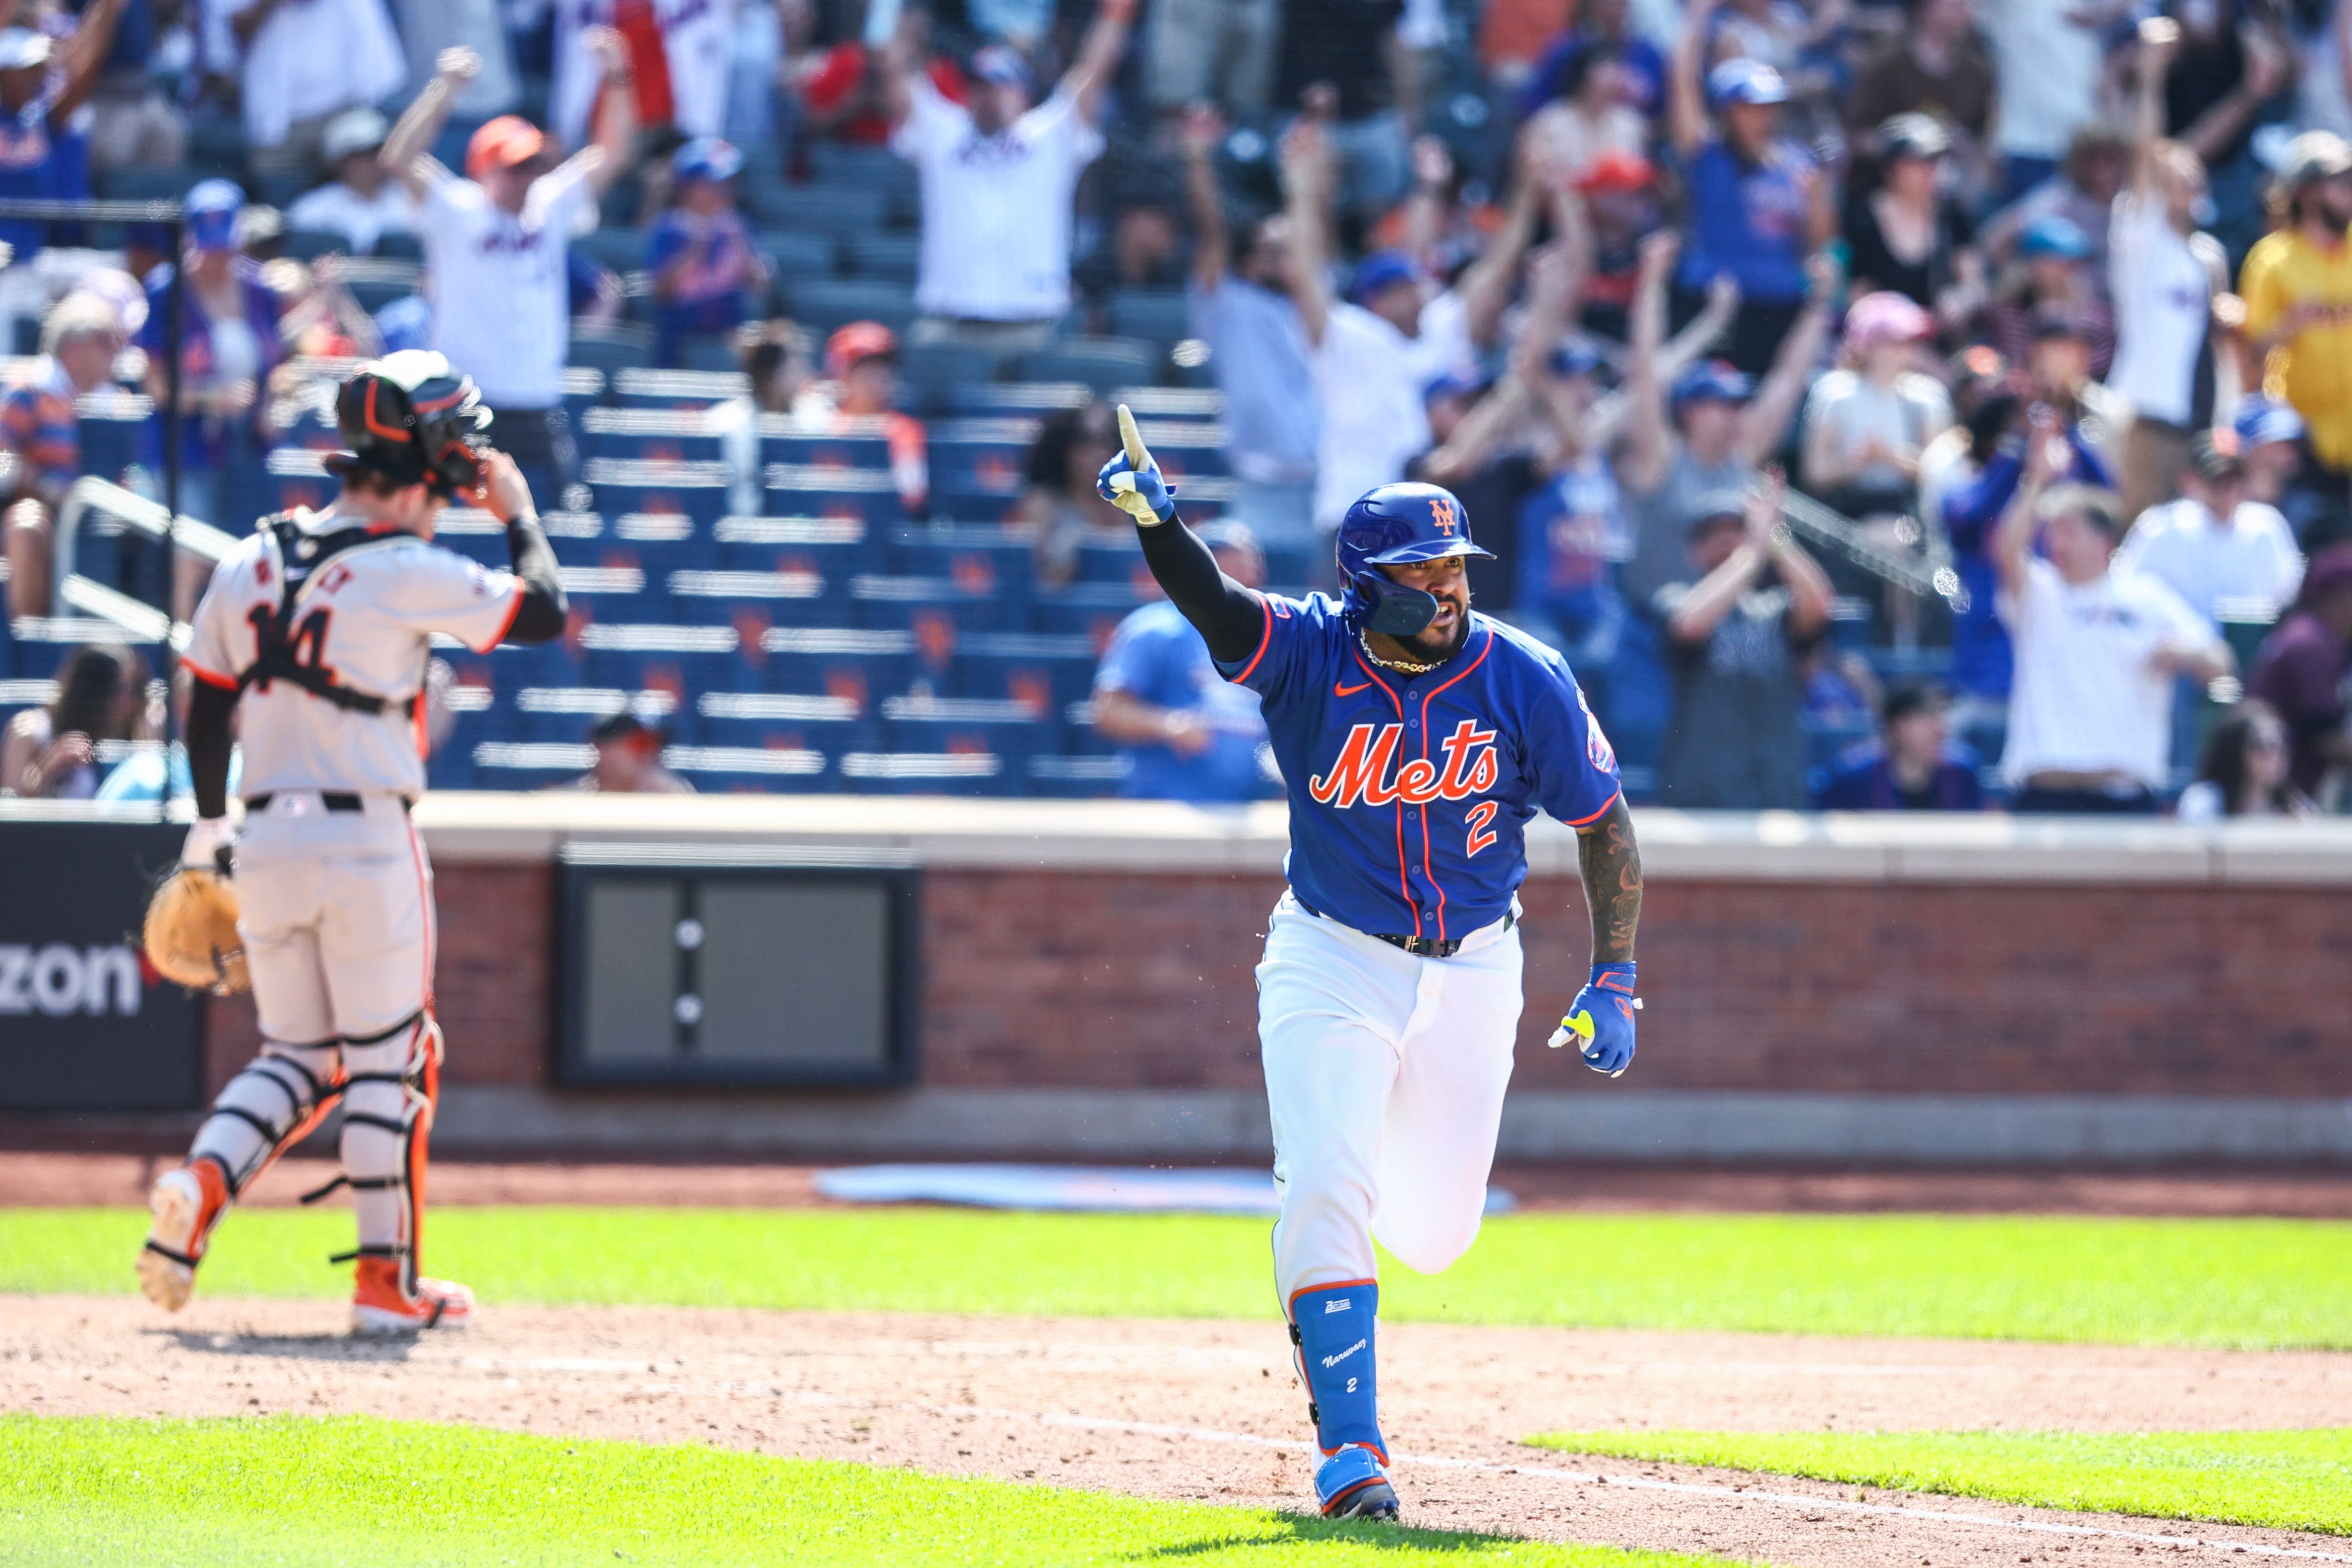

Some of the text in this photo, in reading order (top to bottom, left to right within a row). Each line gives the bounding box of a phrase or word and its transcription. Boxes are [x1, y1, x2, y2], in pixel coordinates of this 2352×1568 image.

[245, 602, 339, 699] 14
[1309, 719, 1498, 809] Mets
[1465, 800, 1498, 858] 2
[1347, 1377, 1358, 1393] 2
